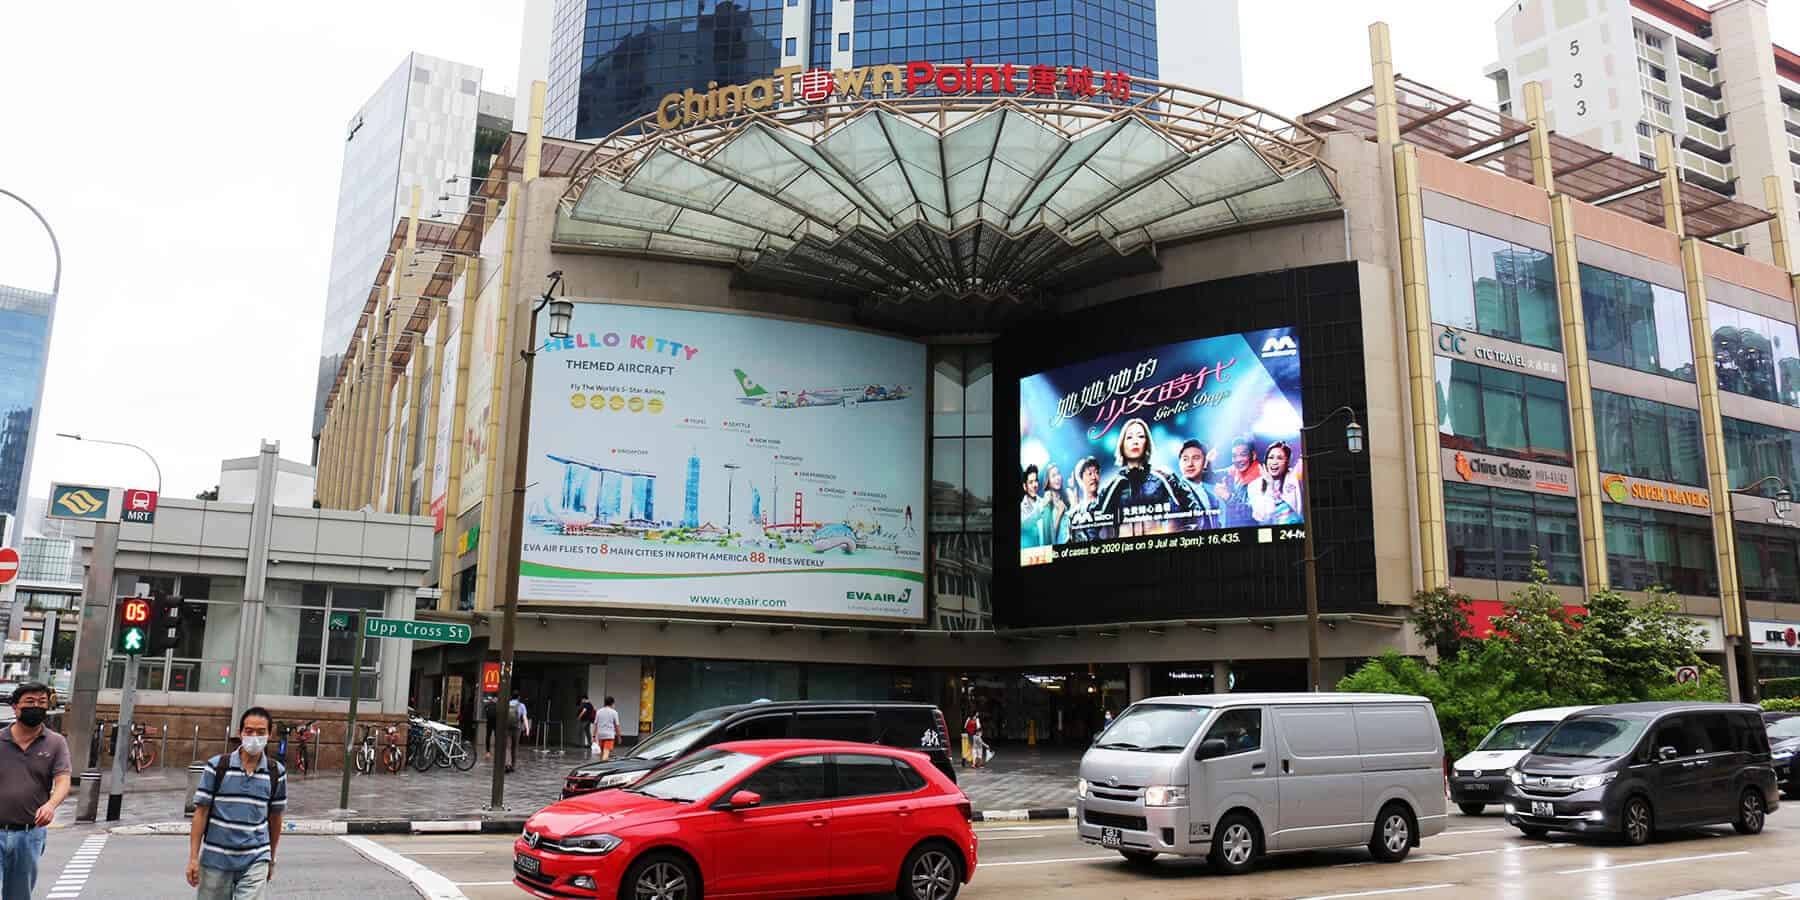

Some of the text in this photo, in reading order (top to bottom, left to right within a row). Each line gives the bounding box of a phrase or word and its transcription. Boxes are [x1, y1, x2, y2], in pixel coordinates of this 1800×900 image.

[906, 58, 1017, 94] Point
[1027, 63, 1130, 101] 唐城坊
[630, 334, 699, 360] KITTY
[1474, 346, 1493, 361] CTC
[1493, 350, 1527, 368] TRAVEL
[566, 359, 675, 376] THEMED AIRCRAFT
[570, 383, 581, 392] Fly
[582, 383, 594, 391] The
[1153, 403, 1189, 422] Girlie
[1499, 461, 1532, 481] Classic
[1631, 482, 1711, 509] SUPER TRAVELS
[127, 511, 151, 521] MRT
[523, 543, 825, 568] EVA AIR FLIES TO 8 MAIN CITIES IN NORTH AMERICA 88 TIMES WEEKLY
[1090, 545, 1101, 554] for
[1101, 543, 1121, 554] 2020
[1135, 541, 1146, 550] on
[1148, 540, 1154, 549] 9
[1155, 538, 1169, 549] Jul
[1169, 538, 1178, 547] at
[689, 593, 788, 608] www.evaair.com
[126, 603, 147, 621] 05
[369, 619, 464, 639] Upp Cross St
